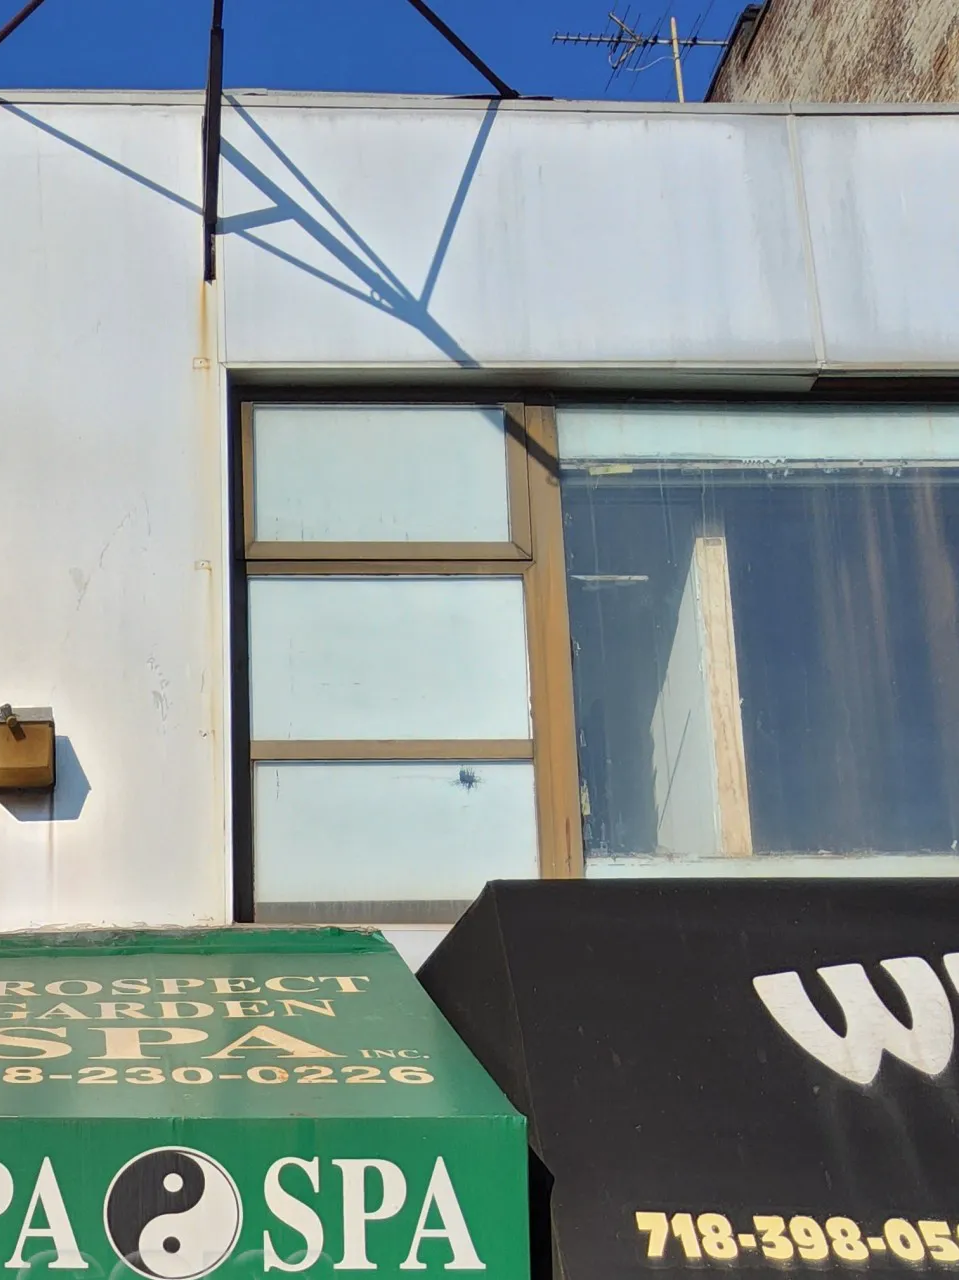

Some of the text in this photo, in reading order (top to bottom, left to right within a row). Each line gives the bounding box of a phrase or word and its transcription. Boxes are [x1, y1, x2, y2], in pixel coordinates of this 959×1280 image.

[359, 1048, 430, 1060] INC.
[752, 952, 959, 1085] W
[262, 1155, 486, 1272] SPA
[635, 1211, 959, 1265] 718-398-05
